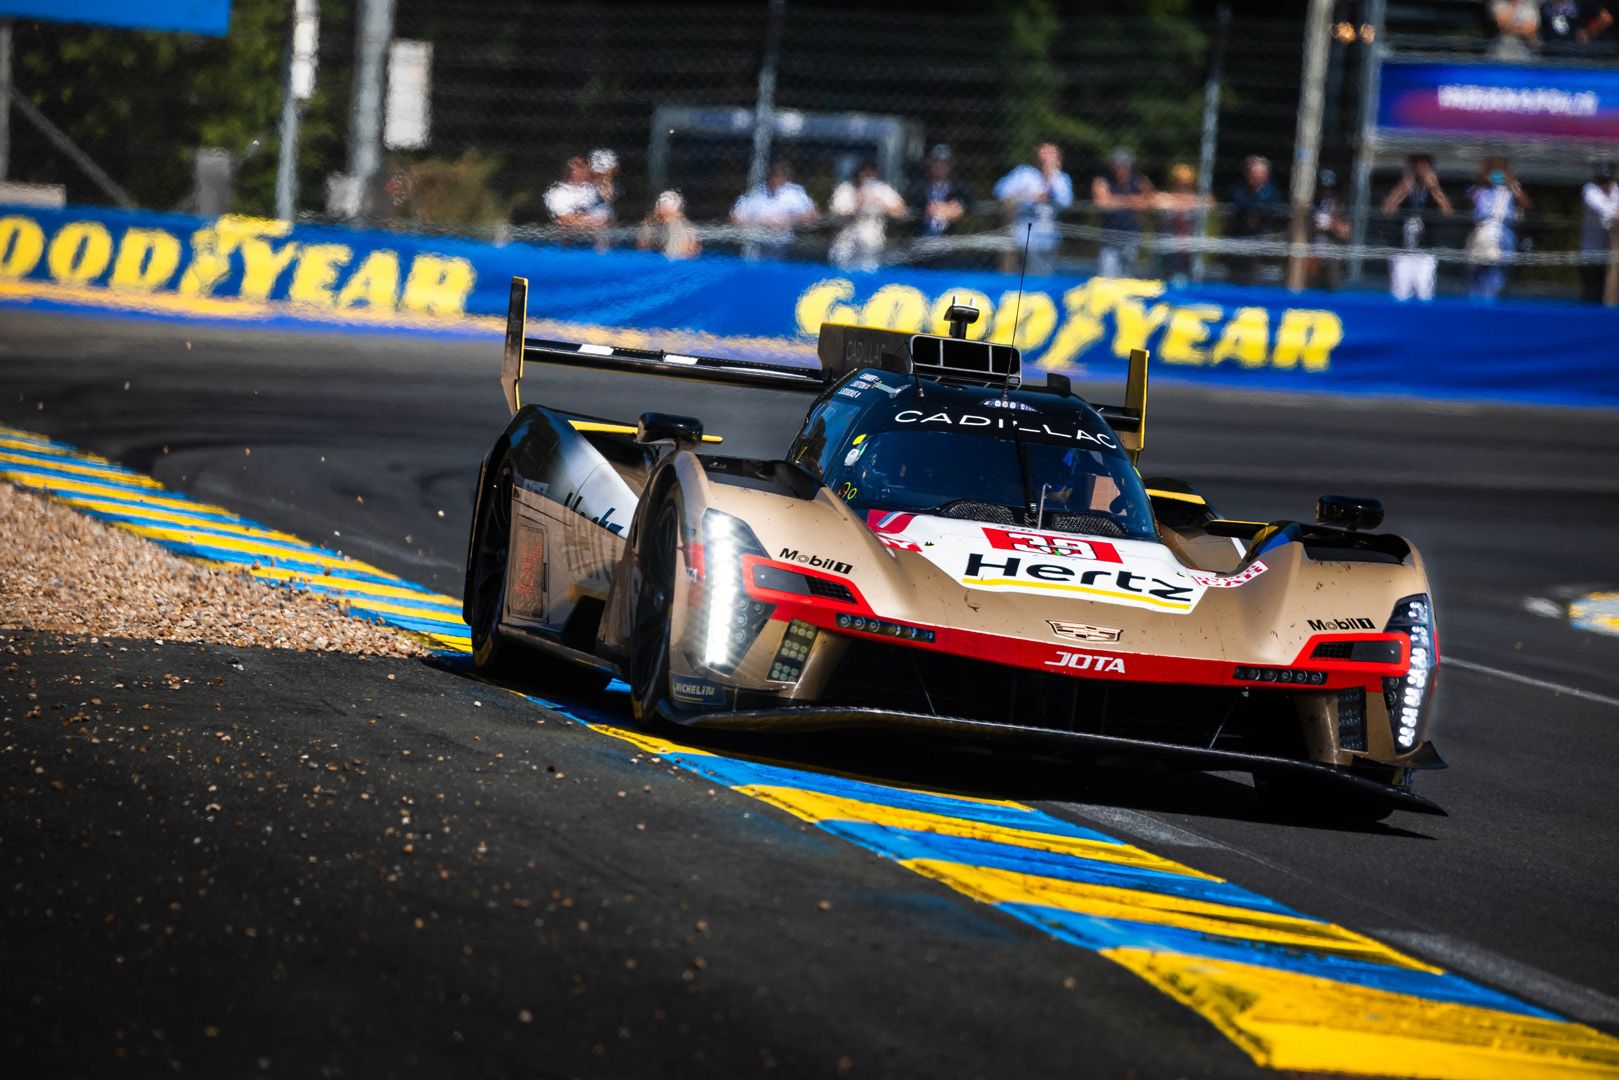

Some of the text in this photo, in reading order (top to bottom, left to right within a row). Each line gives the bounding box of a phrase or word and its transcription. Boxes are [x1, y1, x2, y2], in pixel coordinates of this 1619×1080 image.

[795, 277, 1343, 371] GOODYEAR
[895, 410, 1116, 449] CADILLAC
[964, 553, 1193, 601] Hertz
[1044, 651, 1125, 673] JOTA
